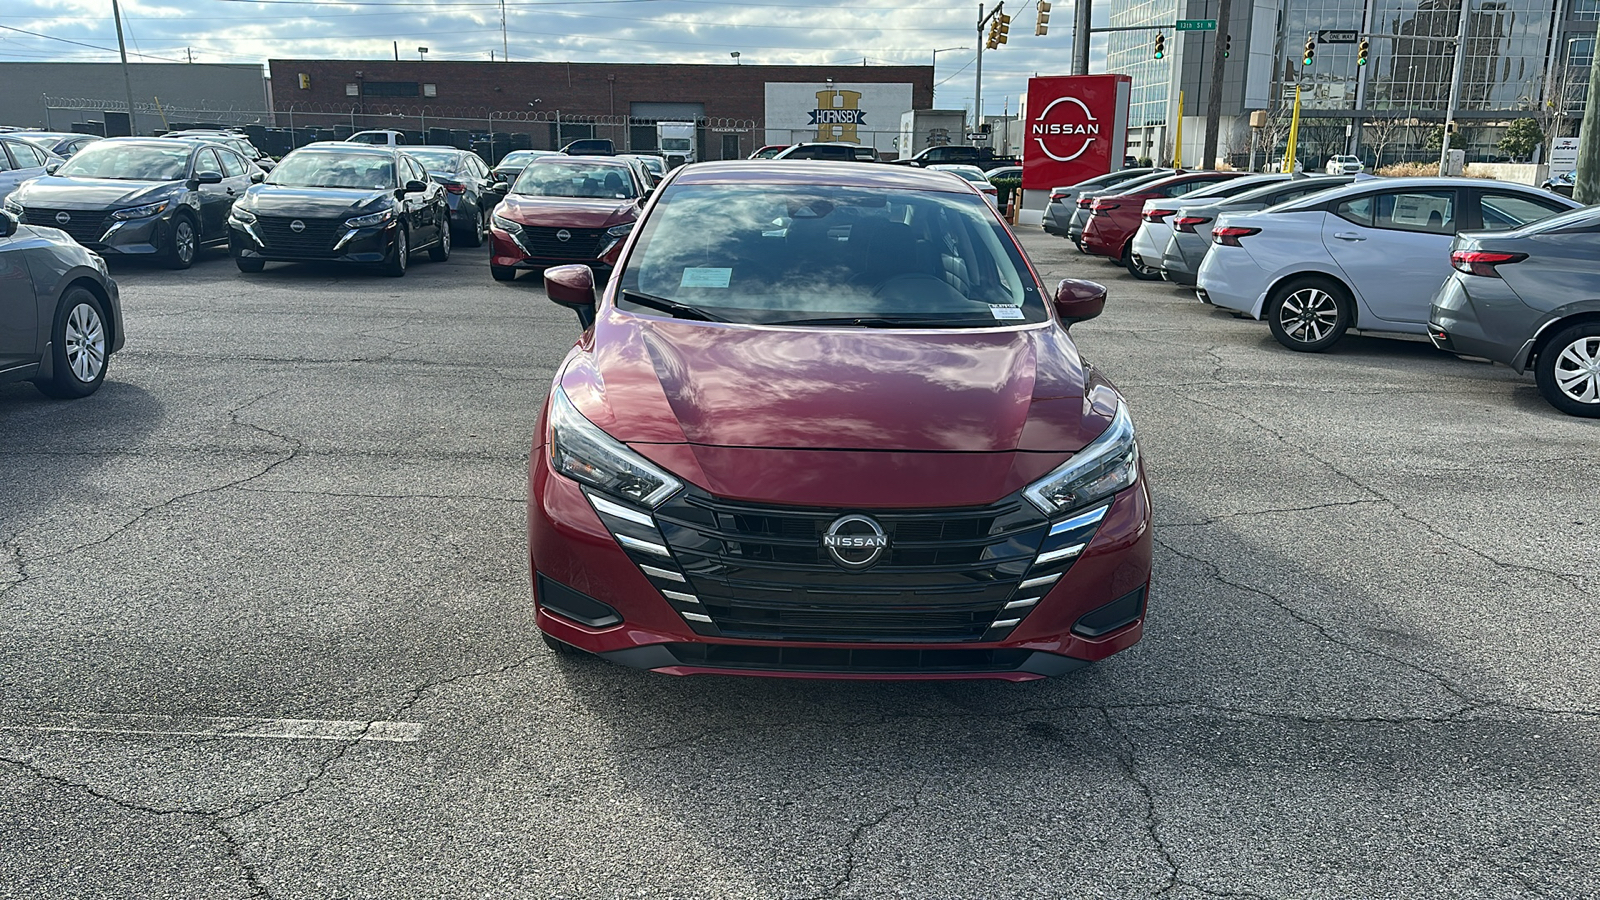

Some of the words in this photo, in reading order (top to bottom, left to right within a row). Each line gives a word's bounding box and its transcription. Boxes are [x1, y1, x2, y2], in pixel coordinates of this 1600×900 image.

[816, 110, 860, 124] HORNSBY
[1032, 123, 1100, 134] NISSAN
[824, 536, 887, 547] NISSAN
